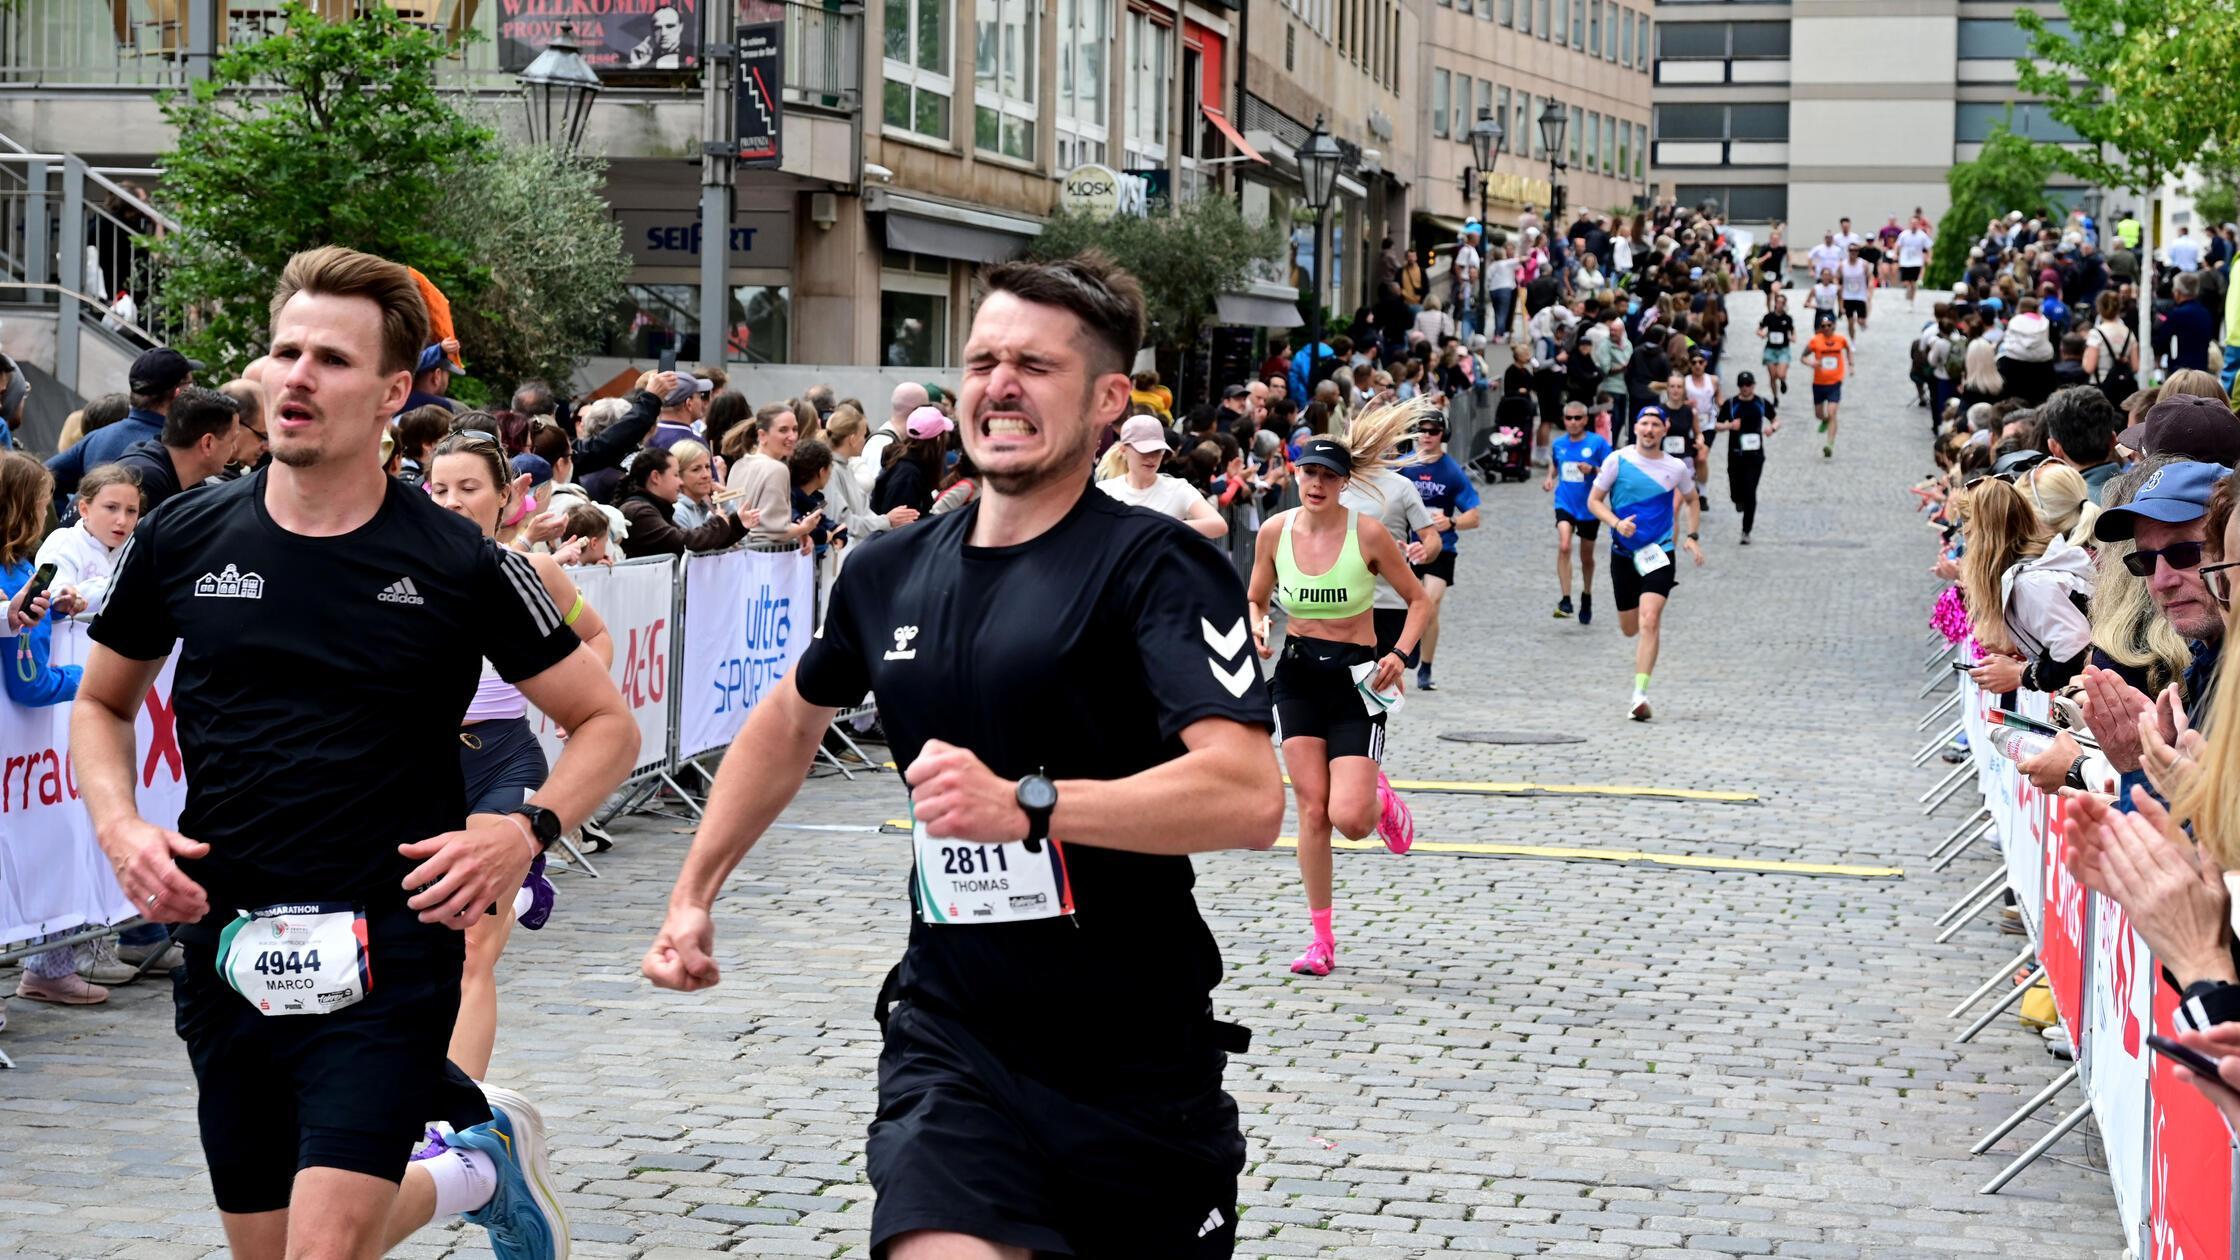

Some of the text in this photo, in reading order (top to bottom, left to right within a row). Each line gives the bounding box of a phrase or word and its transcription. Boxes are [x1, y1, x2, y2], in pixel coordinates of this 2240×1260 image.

[1067, 181, 1114, 197] KIOSK
[377, 592, 424, 605] adidas
[1299, 587, 1348, 603] PUMA
[745, 584, 792, 651] ultra
[621, 618, 665, 710] AEG
[941, 844, 1009, 875] 2811
[951, 878, 1010, 893] THOMAS
[254, 949, 321, 976] 4944
[266, 978, 314, 991] MARCO
